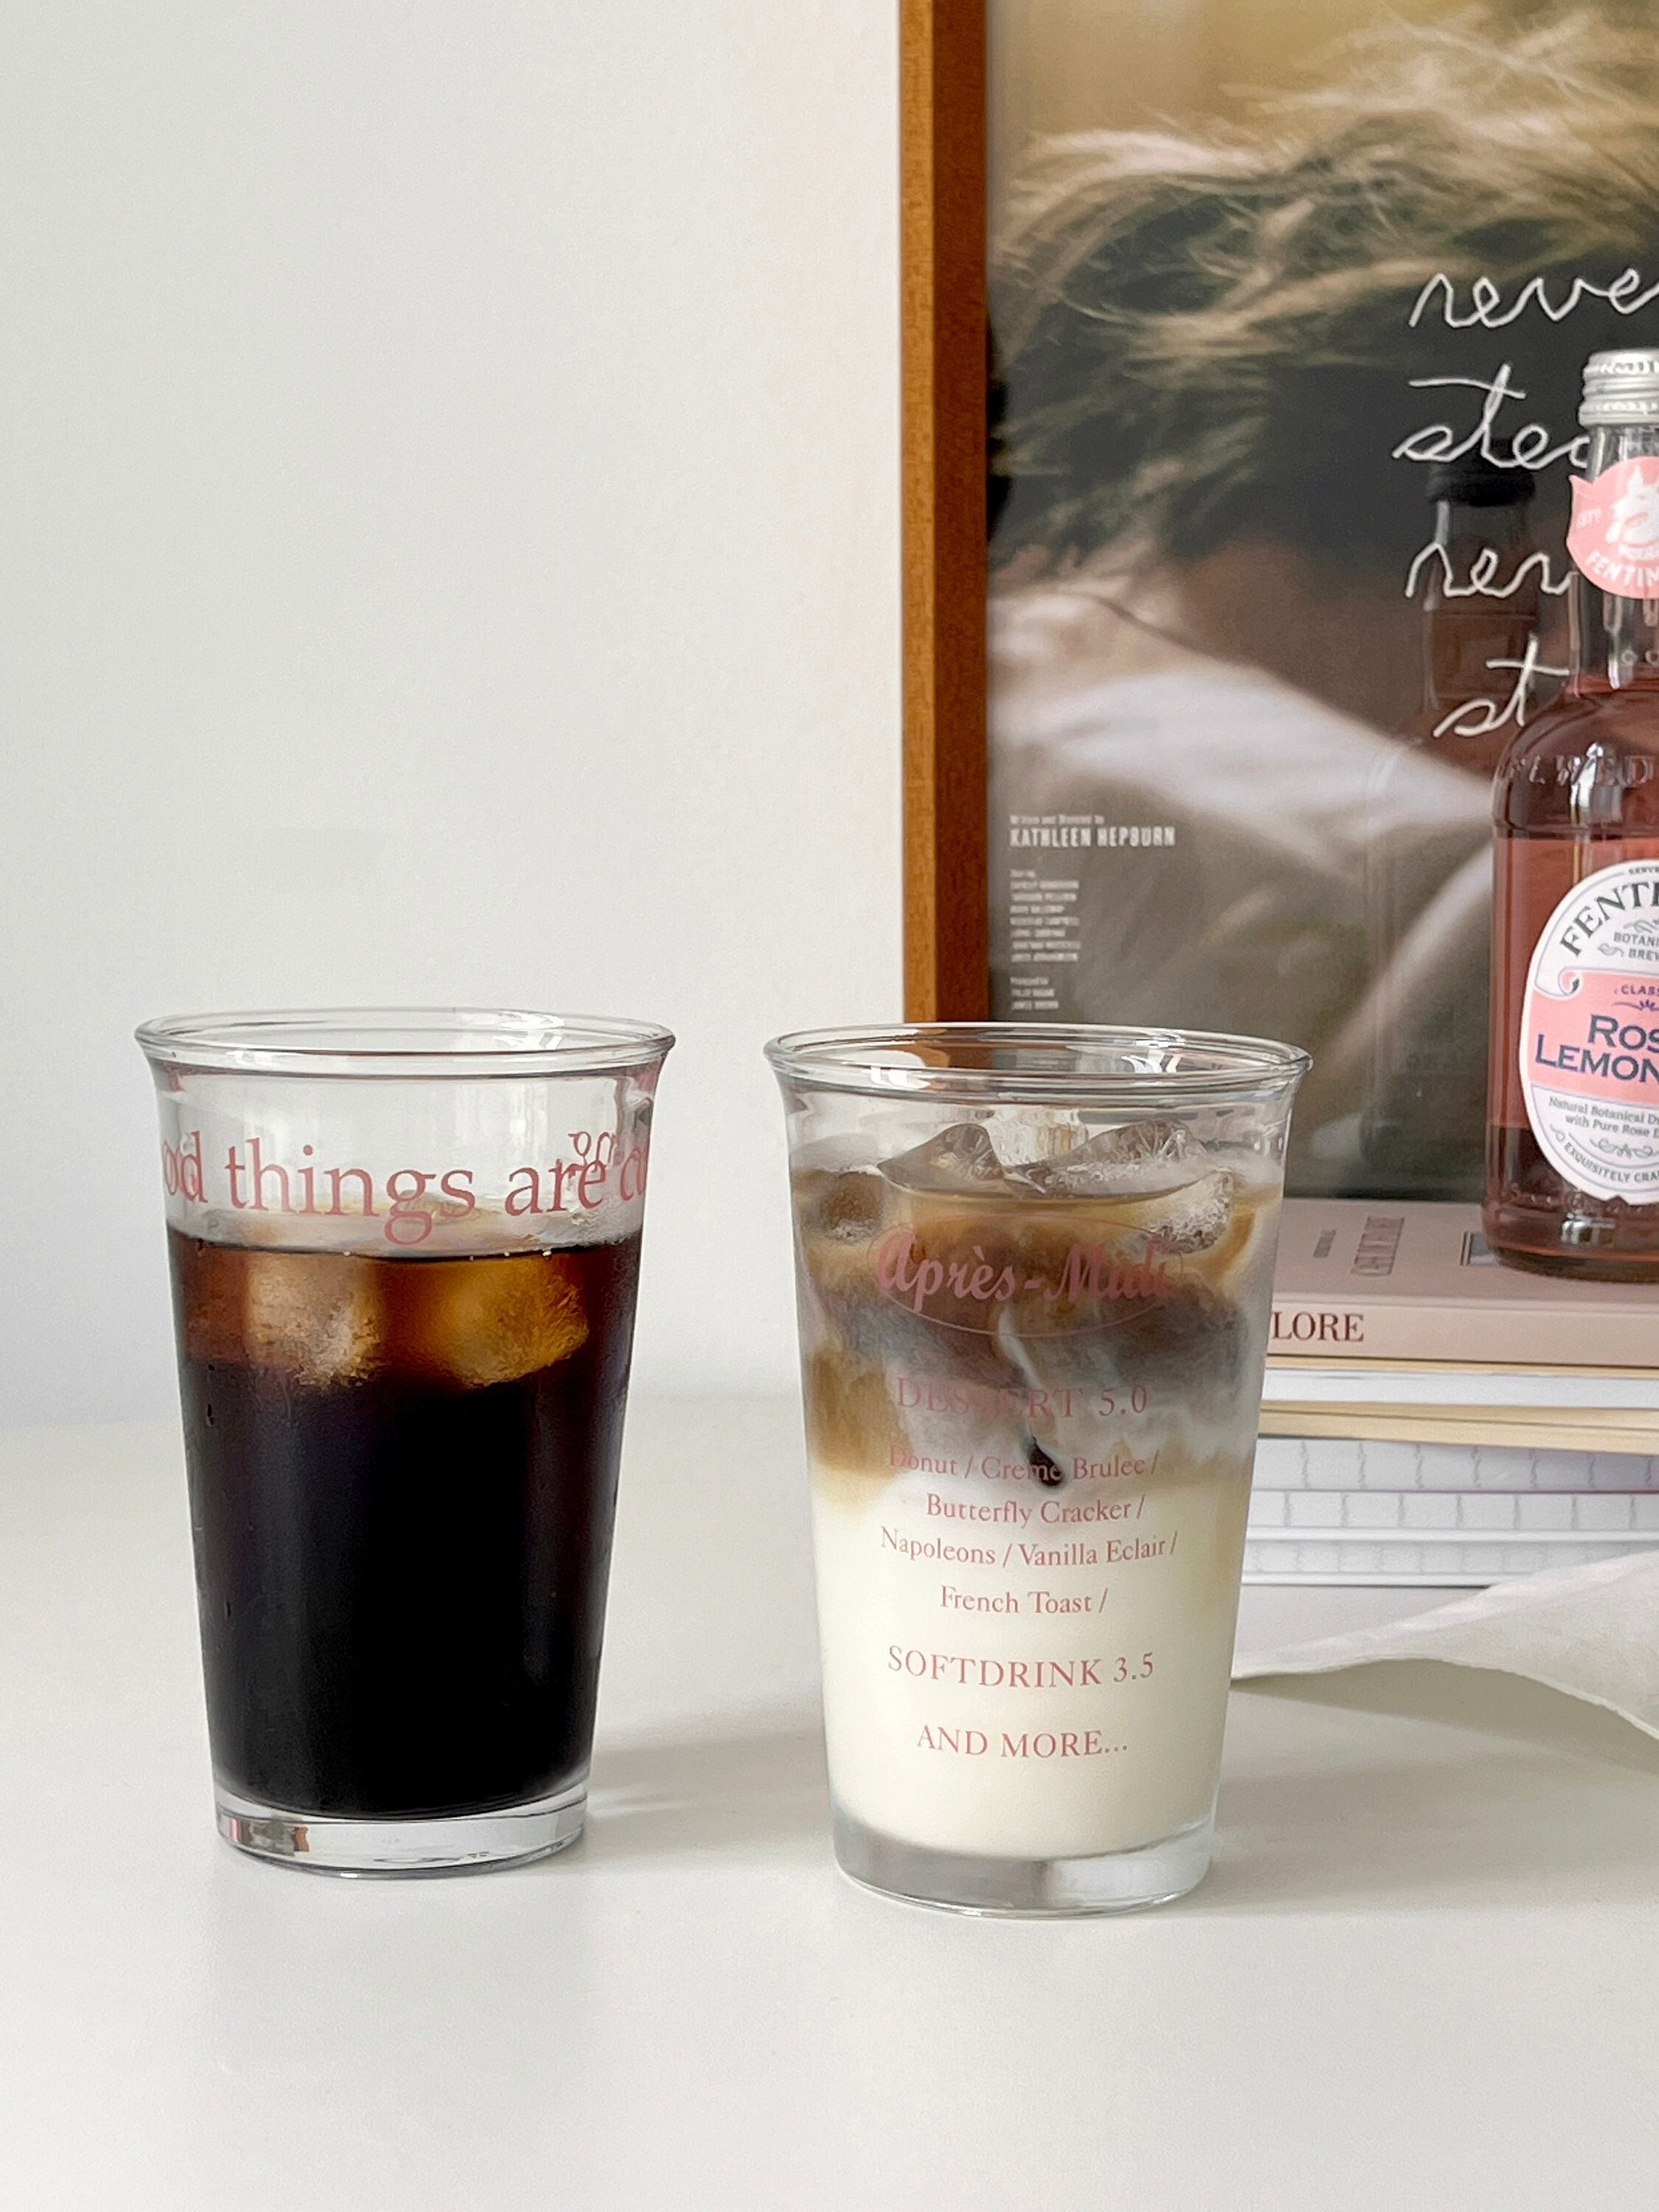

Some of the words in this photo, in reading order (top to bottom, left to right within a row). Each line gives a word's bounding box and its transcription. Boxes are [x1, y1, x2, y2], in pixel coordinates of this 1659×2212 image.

[1009, 827, 1091, 847] KATHLEEN
[1097, 826, 1175, 847] HEPBURN
[1549, 1096, 1588, 1114] Natural
[1591, 1106, 1645, 1123] Botanical
[1565, 1115, 1590, 1128] with
[1593, 1119, 1619, 1133] Pure
[1622, 1124, 1650, 1136] Rose
[1564, 1142, 1630, 1183] EXQUISITELY
[224, 1137, 476, 1246] things
[504, 1158, 607, 1217] are
[1098, 1384, 1149, 1417] 5.0
[888, 1444, 958, 1475] Donut
[981, 1456, 1062, 1481] Creme
[1073, 1455, 1146, 1480] Brulee
[927, 1492, 1032, 1528] Butterfly
[1040, 1496, 1133, 1523] Cracker
[880, 1526, 996, 1565] Napoleons
[1018, 1543, 1098, 1566] Vanilla
[1106, 1536, 1166, 1563] Eclair
[940, 1585, 1019, 1613] French
[1027, 1590, 1092, 1614] Toast
[888, 1645, 1103, 1688] SOFTDRINK
[1113, 1651, 1155, 1683] 3.5
[917, 1725, 989, 1756] AND
